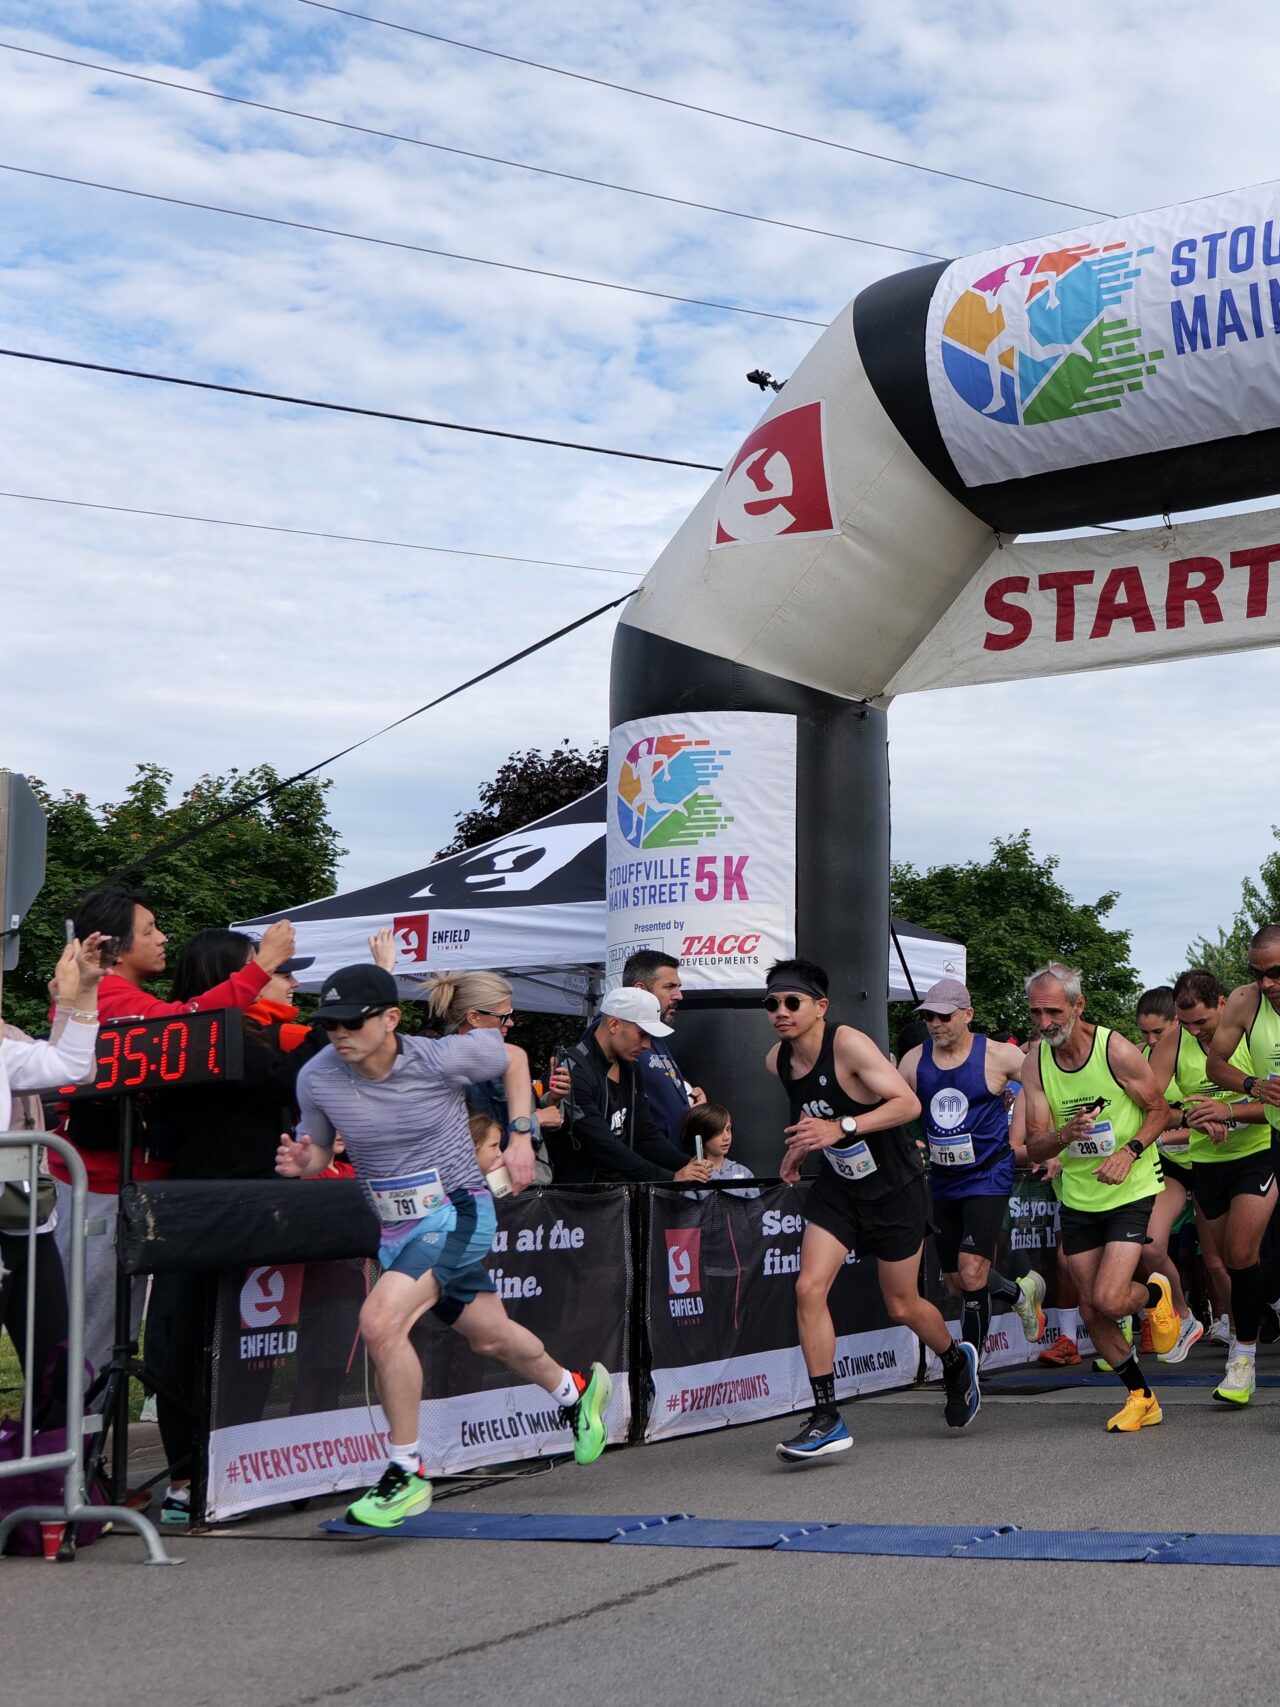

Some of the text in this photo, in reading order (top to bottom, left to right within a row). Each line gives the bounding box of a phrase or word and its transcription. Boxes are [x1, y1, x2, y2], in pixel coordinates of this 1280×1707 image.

[608, 857, 691, 888] STOUFFVILLE
[694, 855, 750, 902] 5K
[608, 882, 689, 913] MAIN STREET
[432, 928, 470, 944] ENFIELD
[634, 919, 685, 933] Presented by
[436, 943, 464, 951] TIMING
[680, 934, 762, 957] TACC
[679, 956, 759, 967] DEVELOPMENTS
[1061, 1096, 1095, 1105] NEWMARKET
[937, 1151, 956, 1163] 779
[1077, 1141, 1099, 1155] 289
[393, 1197, 418, 1217] 791
[516, 1223, 544, 1252] at
[549, 1219, 585, 1250] the
[763, 1246, 801, 1276] fini
[669, 1296, 705, 1318] ENFIELD
[240, 1330, 298, 1359] ENFIELD
[666, 1373, 770, 1414] #EVERYSTEPCOUNTS
